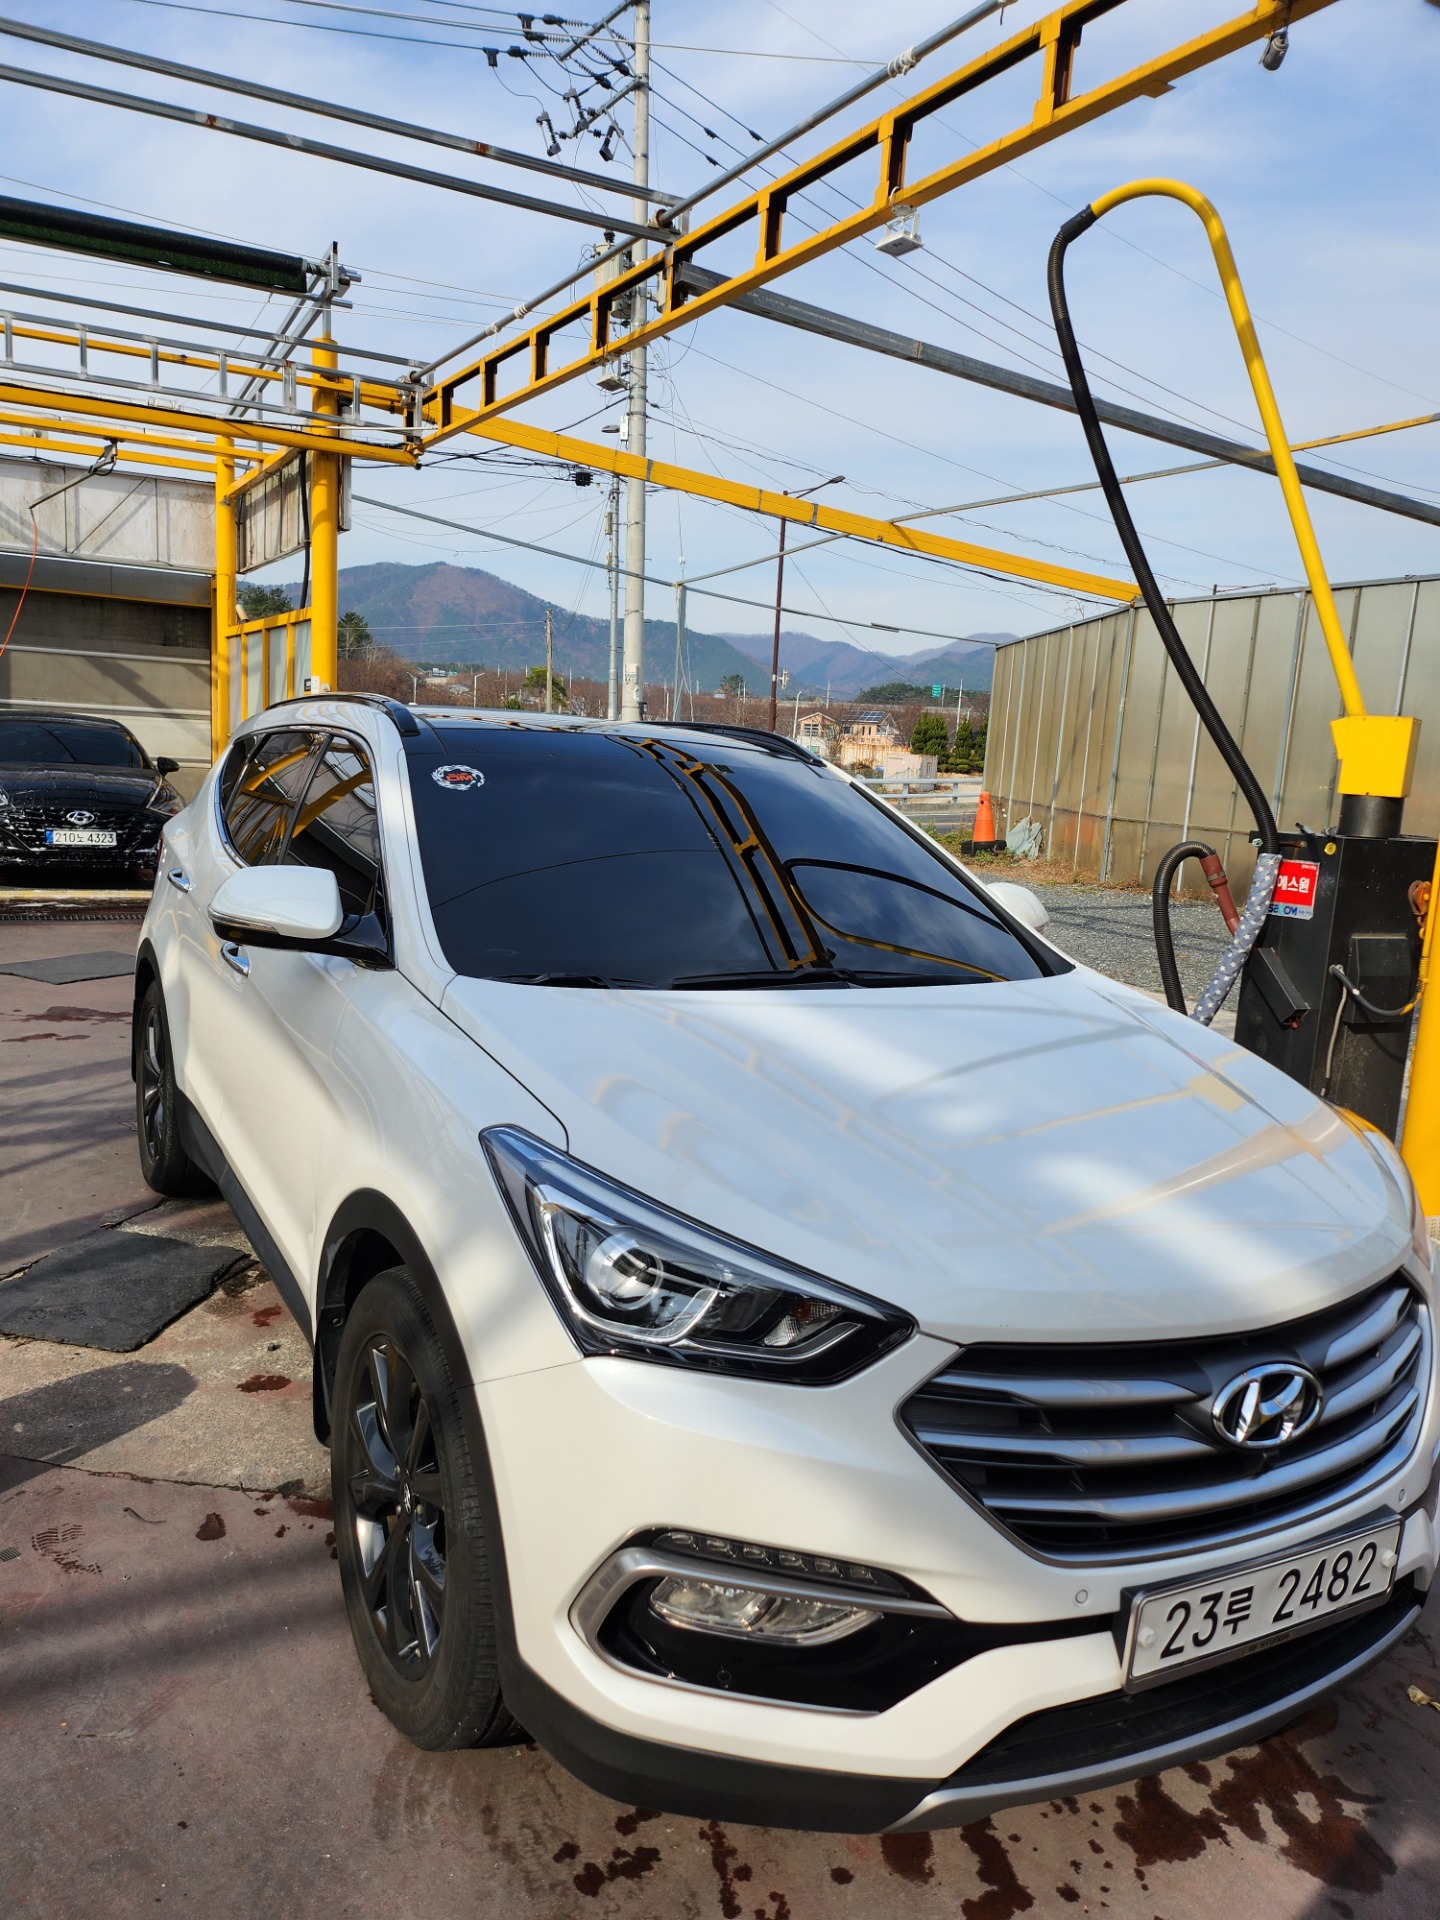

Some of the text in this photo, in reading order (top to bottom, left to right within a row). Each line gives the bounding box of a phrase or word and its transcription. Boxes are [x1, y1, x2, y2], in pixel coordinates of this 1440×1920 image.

[87, 833, 114, 844] 4323
[1277, 875, 1310, 894] 에스원
[1160, 1541, 1378, 1660] 23루 2482
